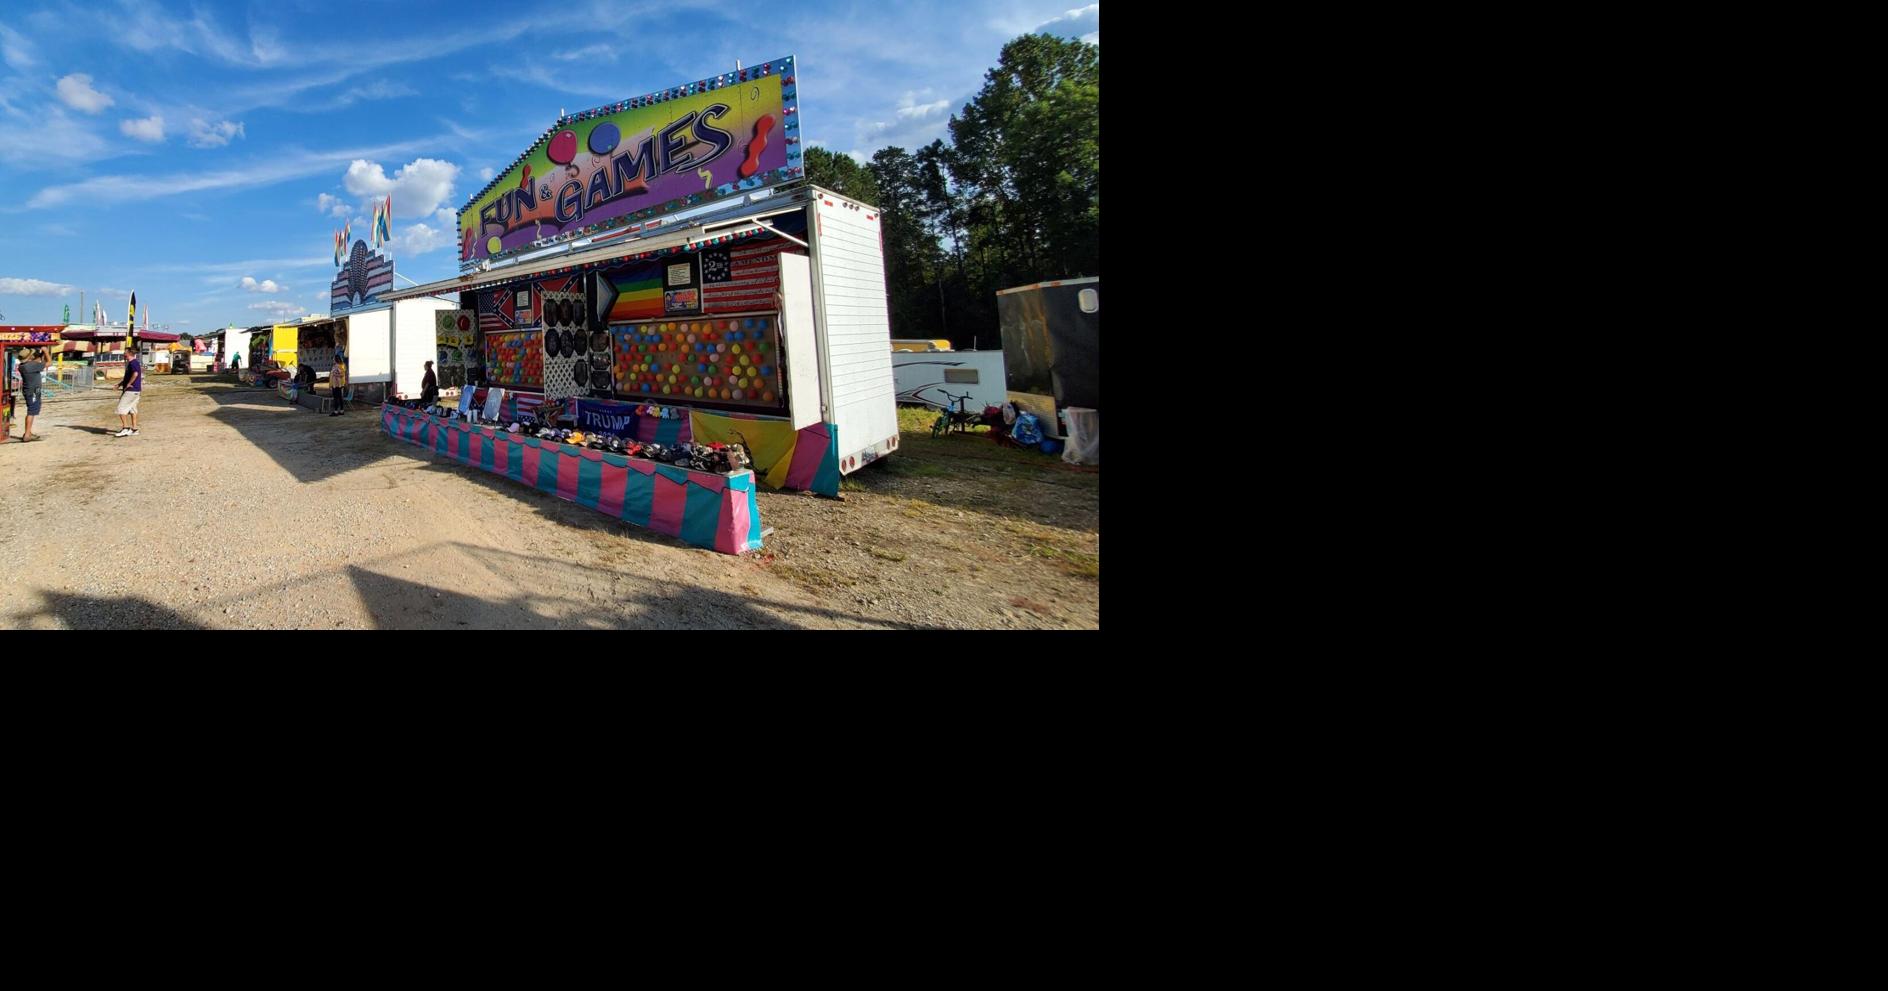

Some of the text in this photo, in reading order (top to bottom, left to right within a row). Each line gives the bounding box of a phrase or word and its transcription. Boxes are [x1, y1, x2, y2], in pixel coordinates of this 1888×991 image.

[478, 103, 731, 236] FUN & GAMES
[585, 410, 630, 430] TRUMP
